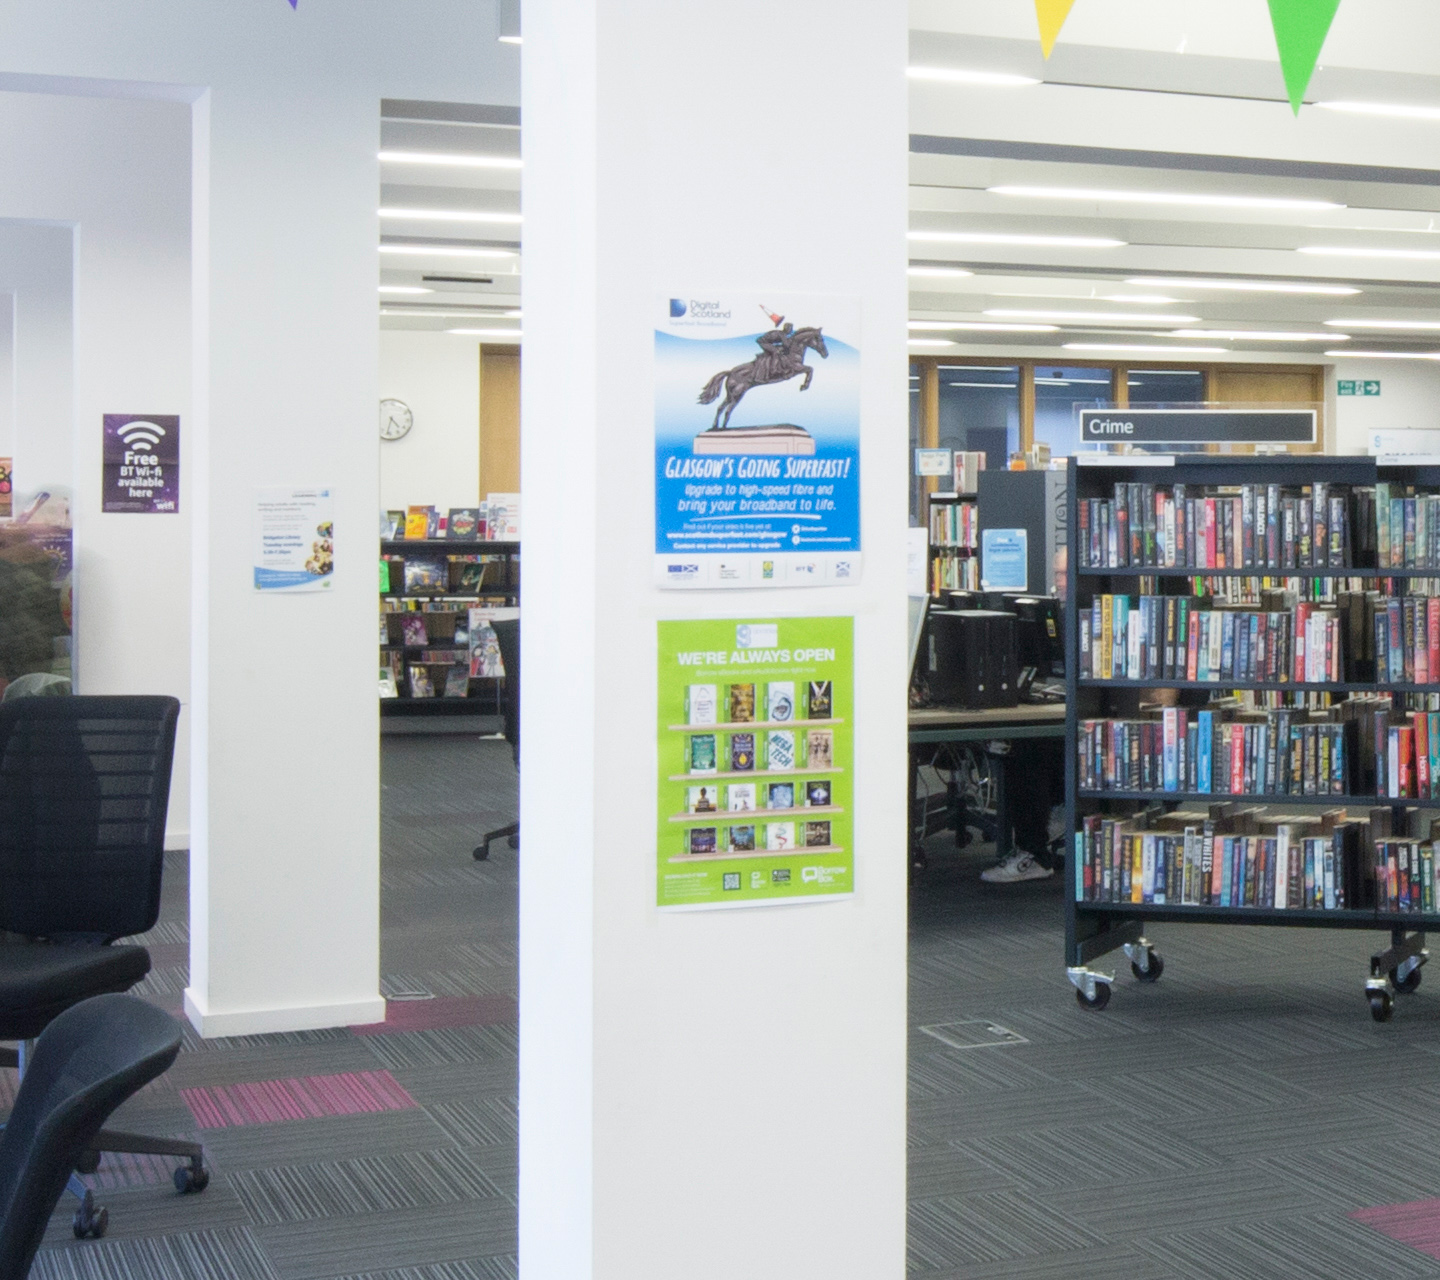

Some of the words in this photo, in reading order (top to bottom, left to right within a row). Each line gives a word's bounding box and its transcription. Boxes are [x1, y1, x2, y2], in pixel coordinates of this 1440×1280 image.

[690, 300, 720, 312] Digital
[690, 309, 732, 319] Scotland
[1089, 419, 1134, 436] Crime
[124, 451, 159, 466] Free
[120, 466, 135, 477] BT
[136, 465, 163, 477] Wi-fi
[117, 477, 165, 488] available
[129, 487, 154, 498] here
[685, 484, 722, 497] Upgrade
[726, 484, 736, 495] to
[739, 484, 791, 498] high-speed
[793, 484, 813, 495] fibre
[816, 484, 835, 496] and
[678, 498, 707, 514] bring
[711, 500, 735, 514] your
[740, 498, 797, 511] broadband
[800, 499, 812, 511] to
[815, 499, 837, 511] life.
[1416, 620, 1426, 649] CHILD
[677, 651, 728, 666] WE'RE
[730, 649, 791, 664] ALWAYS
[793, 648, 836, 663] OPEN
[770, 733, 794, 751] MEGA
[768, 747, 793, 768] TECH
[1419, 755, 1427, 782] Home
